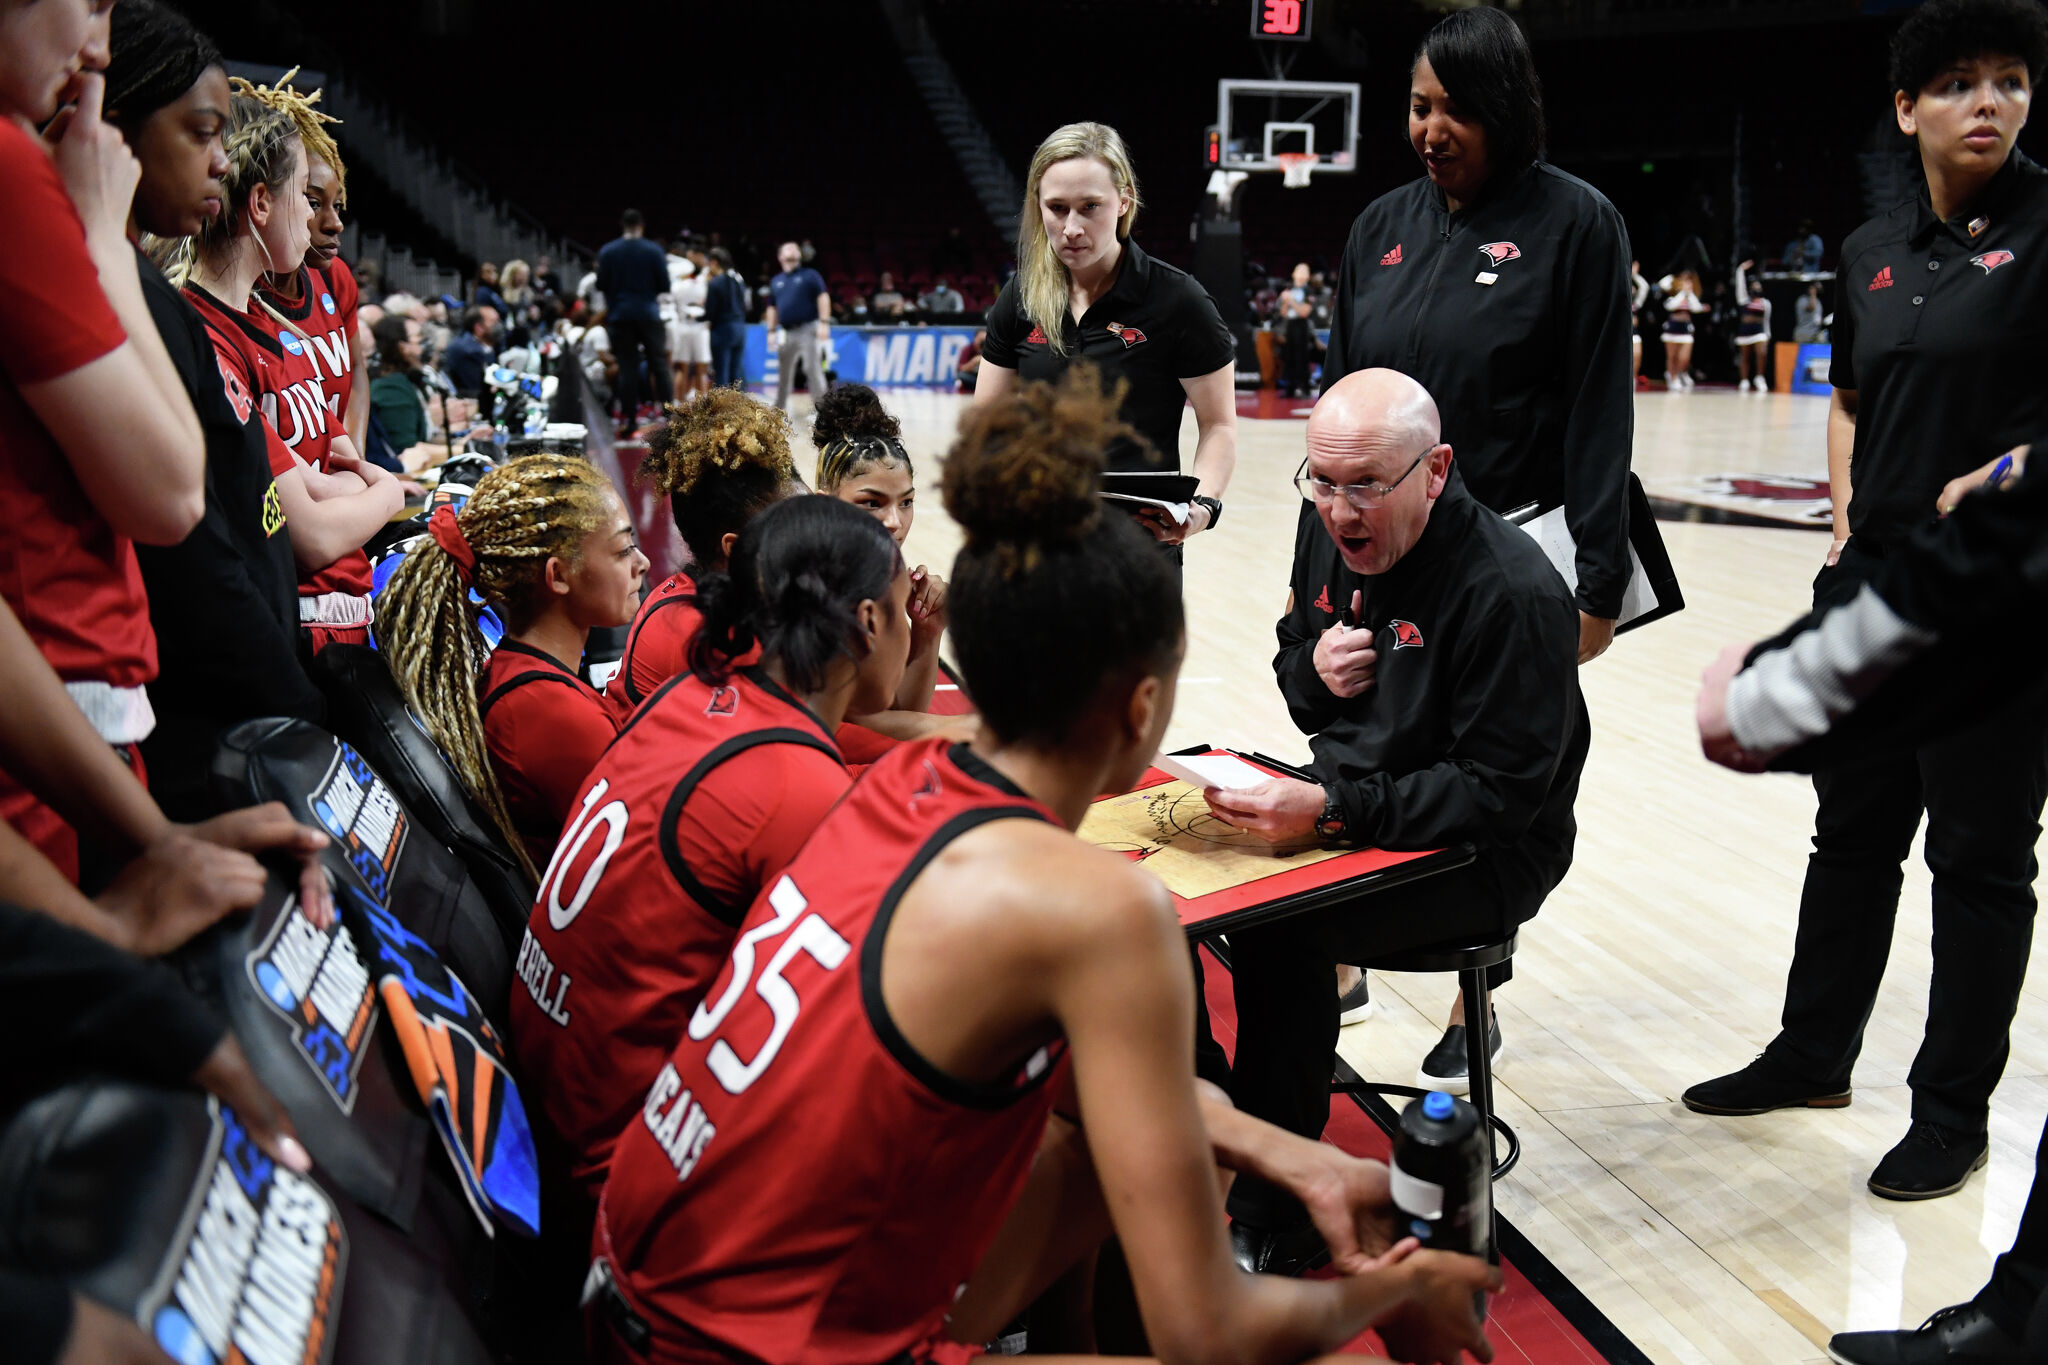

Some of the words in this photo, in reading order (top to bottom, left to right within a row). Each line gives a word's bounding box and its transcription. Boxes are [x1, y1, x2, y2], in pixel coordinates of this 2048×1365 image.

[1263, 0, 1300, 34] 30
[1868, 279, 1895, 292] adidas
[536, 778, 630, 931] 10
[309, 924, 370, 1038] MADNE
[688, 874, 852, 1095] 35
[643, 1061, 717, 1182] EANS
